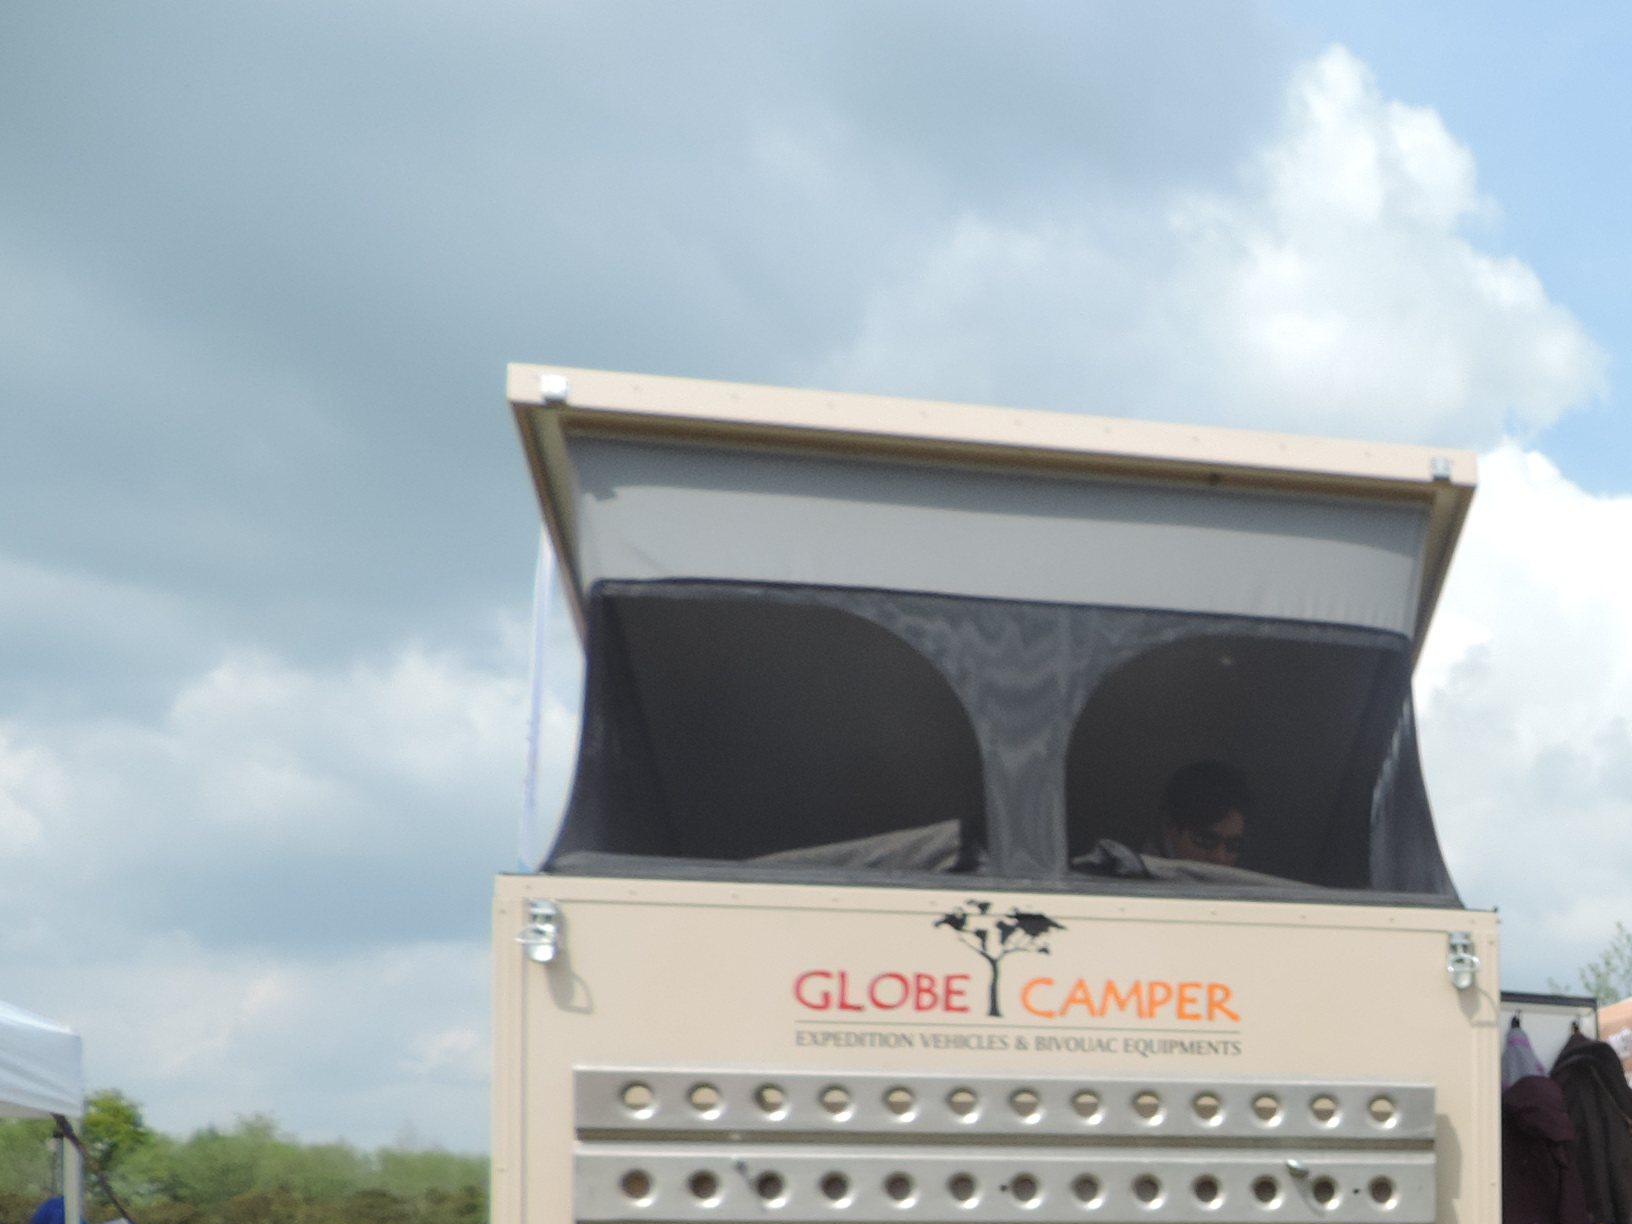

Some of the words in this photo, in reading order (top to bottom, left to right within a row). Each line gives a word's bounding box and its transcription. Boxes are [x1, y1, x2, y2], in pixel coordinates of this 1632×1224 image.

[793, 970, 972, 1013] GLOBE
[1020, 977, 1241, 1022] CAMPER
[796, 1030, 914, 1050] EXPEDITION
[919, 1032, 1008, 1052] VEHICLES
[1014, 1035, 1029, 1052] &
[1034, 1035, 1118, 1054] BIVOUAC
[1123, 1037, 1241, 1058] EQUIPMENTS
